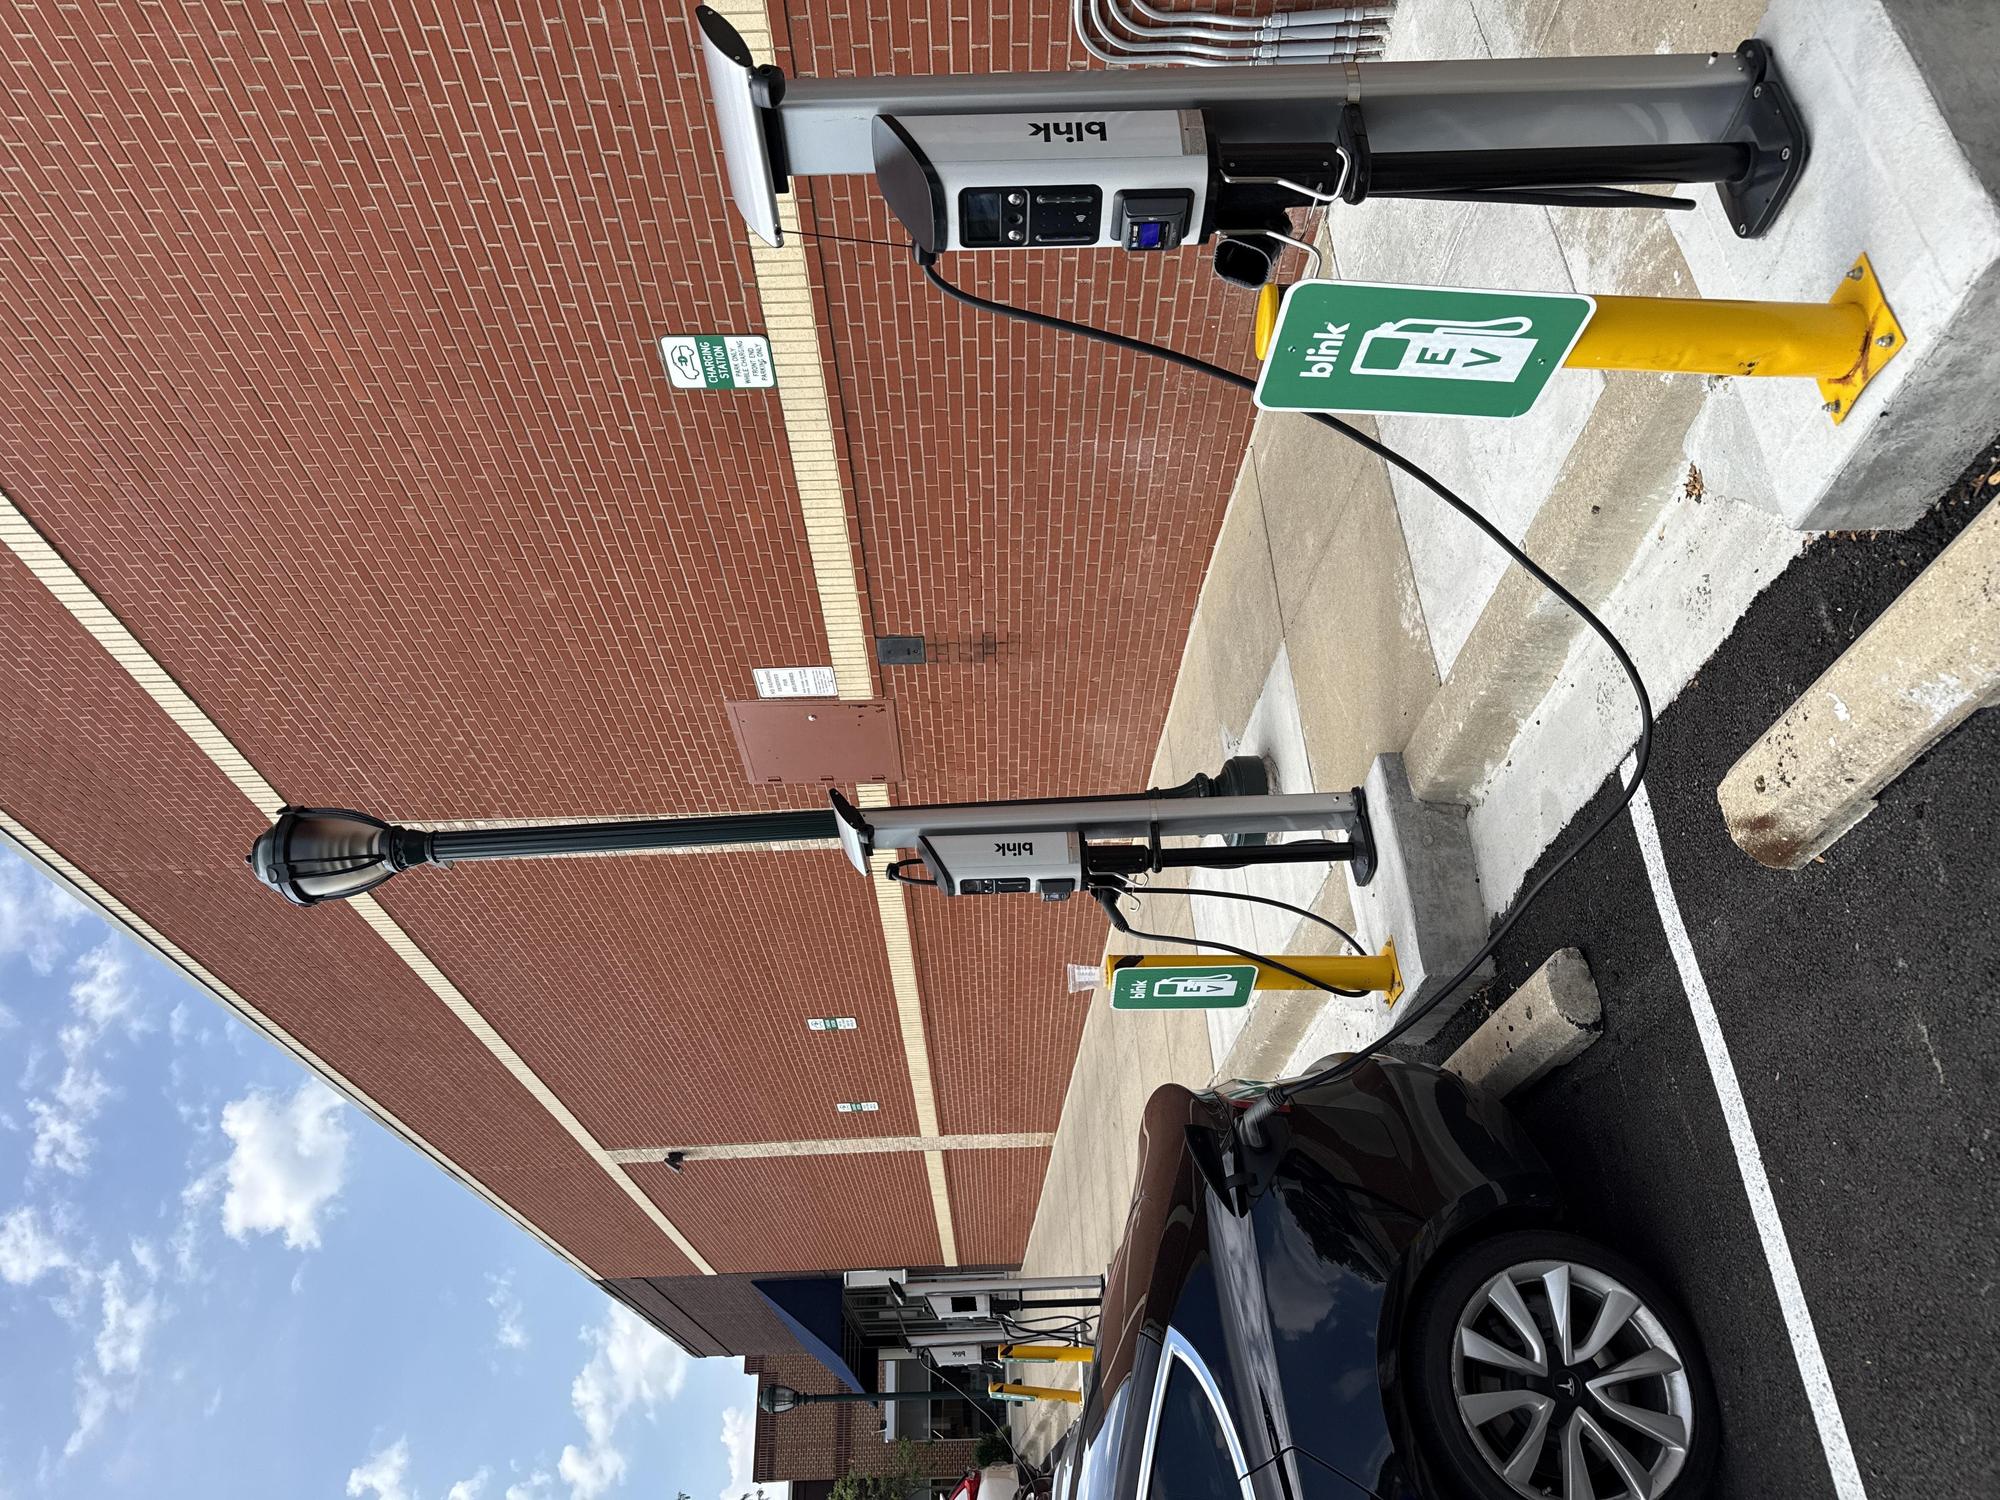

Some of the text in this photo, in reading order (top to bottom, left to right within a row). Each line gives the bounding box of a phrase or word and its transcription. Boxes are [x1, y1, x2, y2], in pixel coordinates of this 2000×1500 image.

[1027, 121, 1108, 143] blink
[699, 341, 719, 383] CHARGING
[712, 345, 730, 379] STATION
[730, 348, 742, 377] PARK ONLY
[736, 341, 752, 384] WHILE CHARGING
[748, 348, 760, 377] FRONT END
[755, 344, 768, 381] PARKING ONLY
[1299, 321, 1351, 378] blink
[764, 671, 773, 688] PARKING
[993, 842, 1034, 856] blink
[1130, 980, 1148, 999] blink
